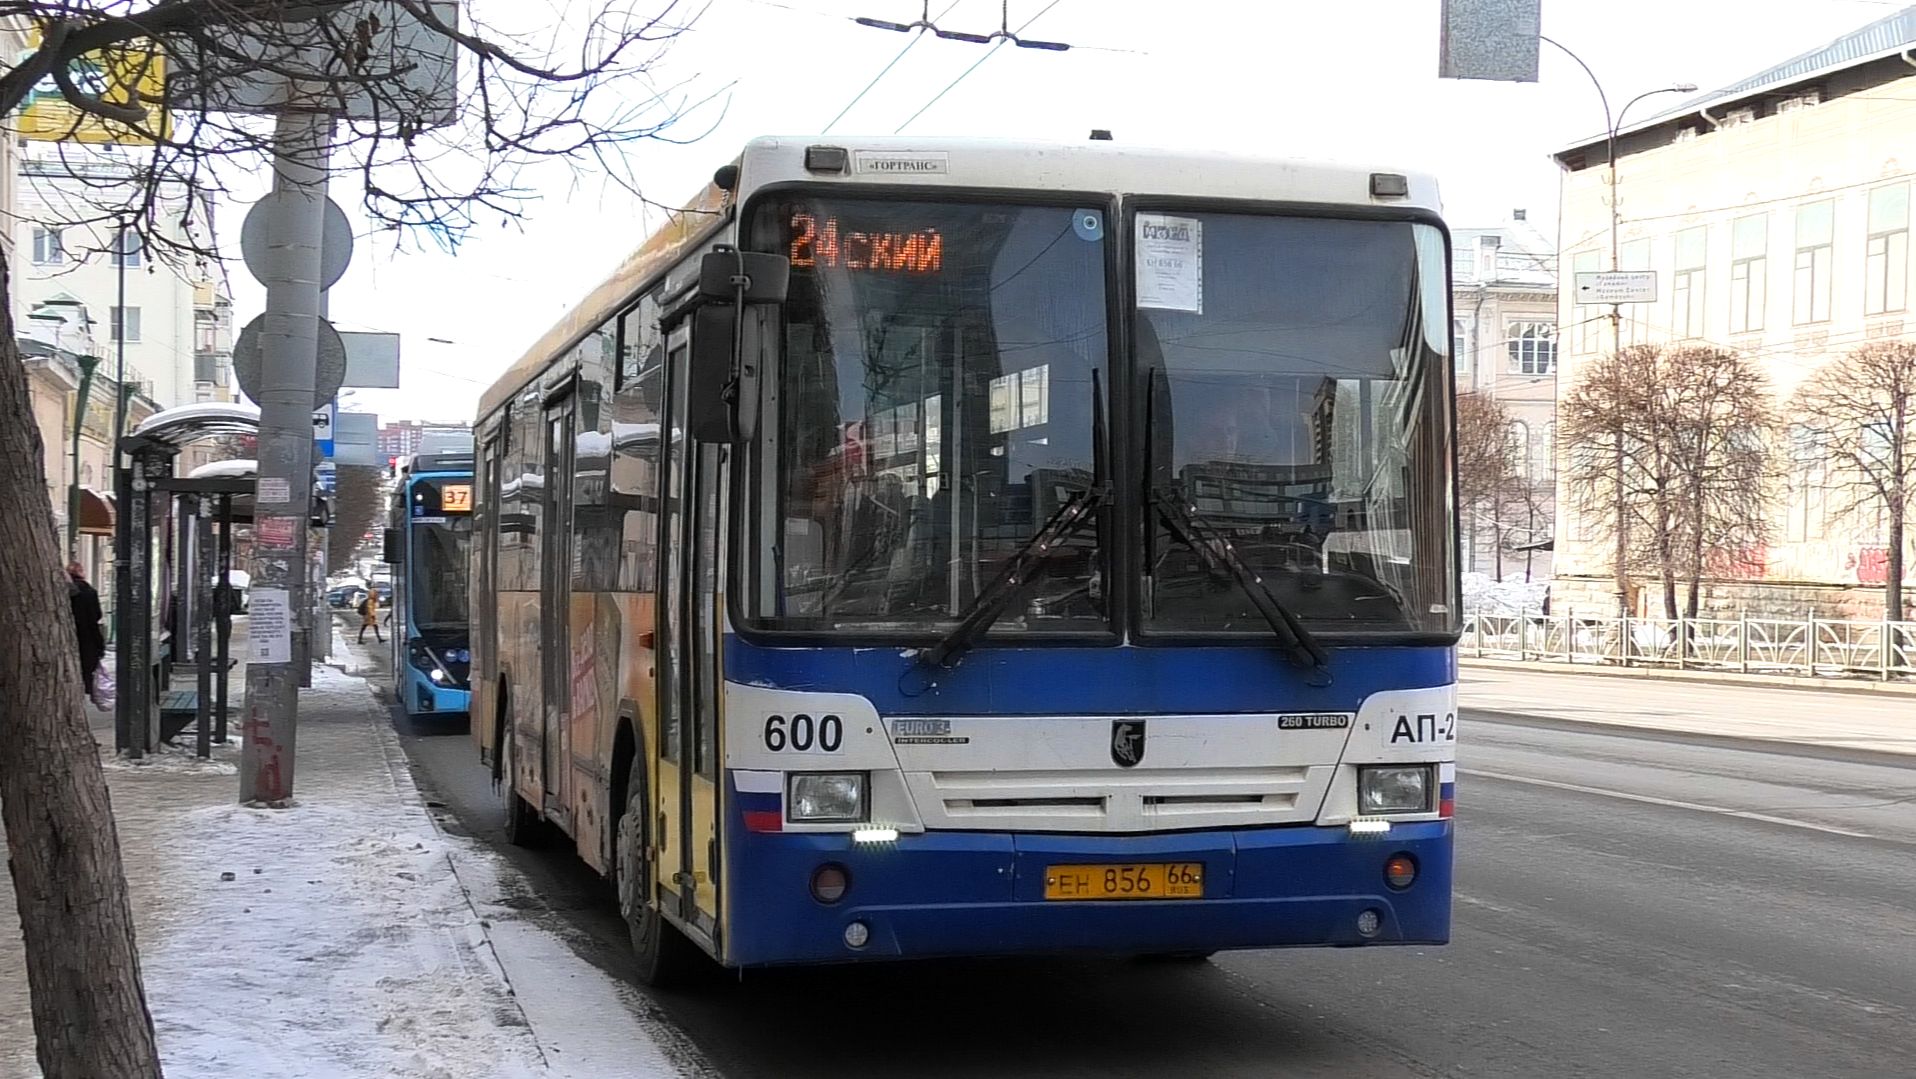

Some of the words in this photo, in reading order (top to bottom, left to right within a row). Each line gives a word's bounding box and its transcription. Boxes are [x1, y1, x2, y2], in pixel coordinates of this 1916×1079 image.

[792, 214, 838, 267] 24
[445, 491, 468, 504] 37
[764, 713, 843, 752] 600
[897, 721, 932, 734] EURO
[1281, 716, 1301, 727] 260
[1305, 716, 1347, 727] TURBO
[1390, 713, 1455, 743] АП-2
[1059, 874, 1089, 894] ЕН
[1104, 867, 1151, 893] 856
[1168, 864, 1192, 884] 66
